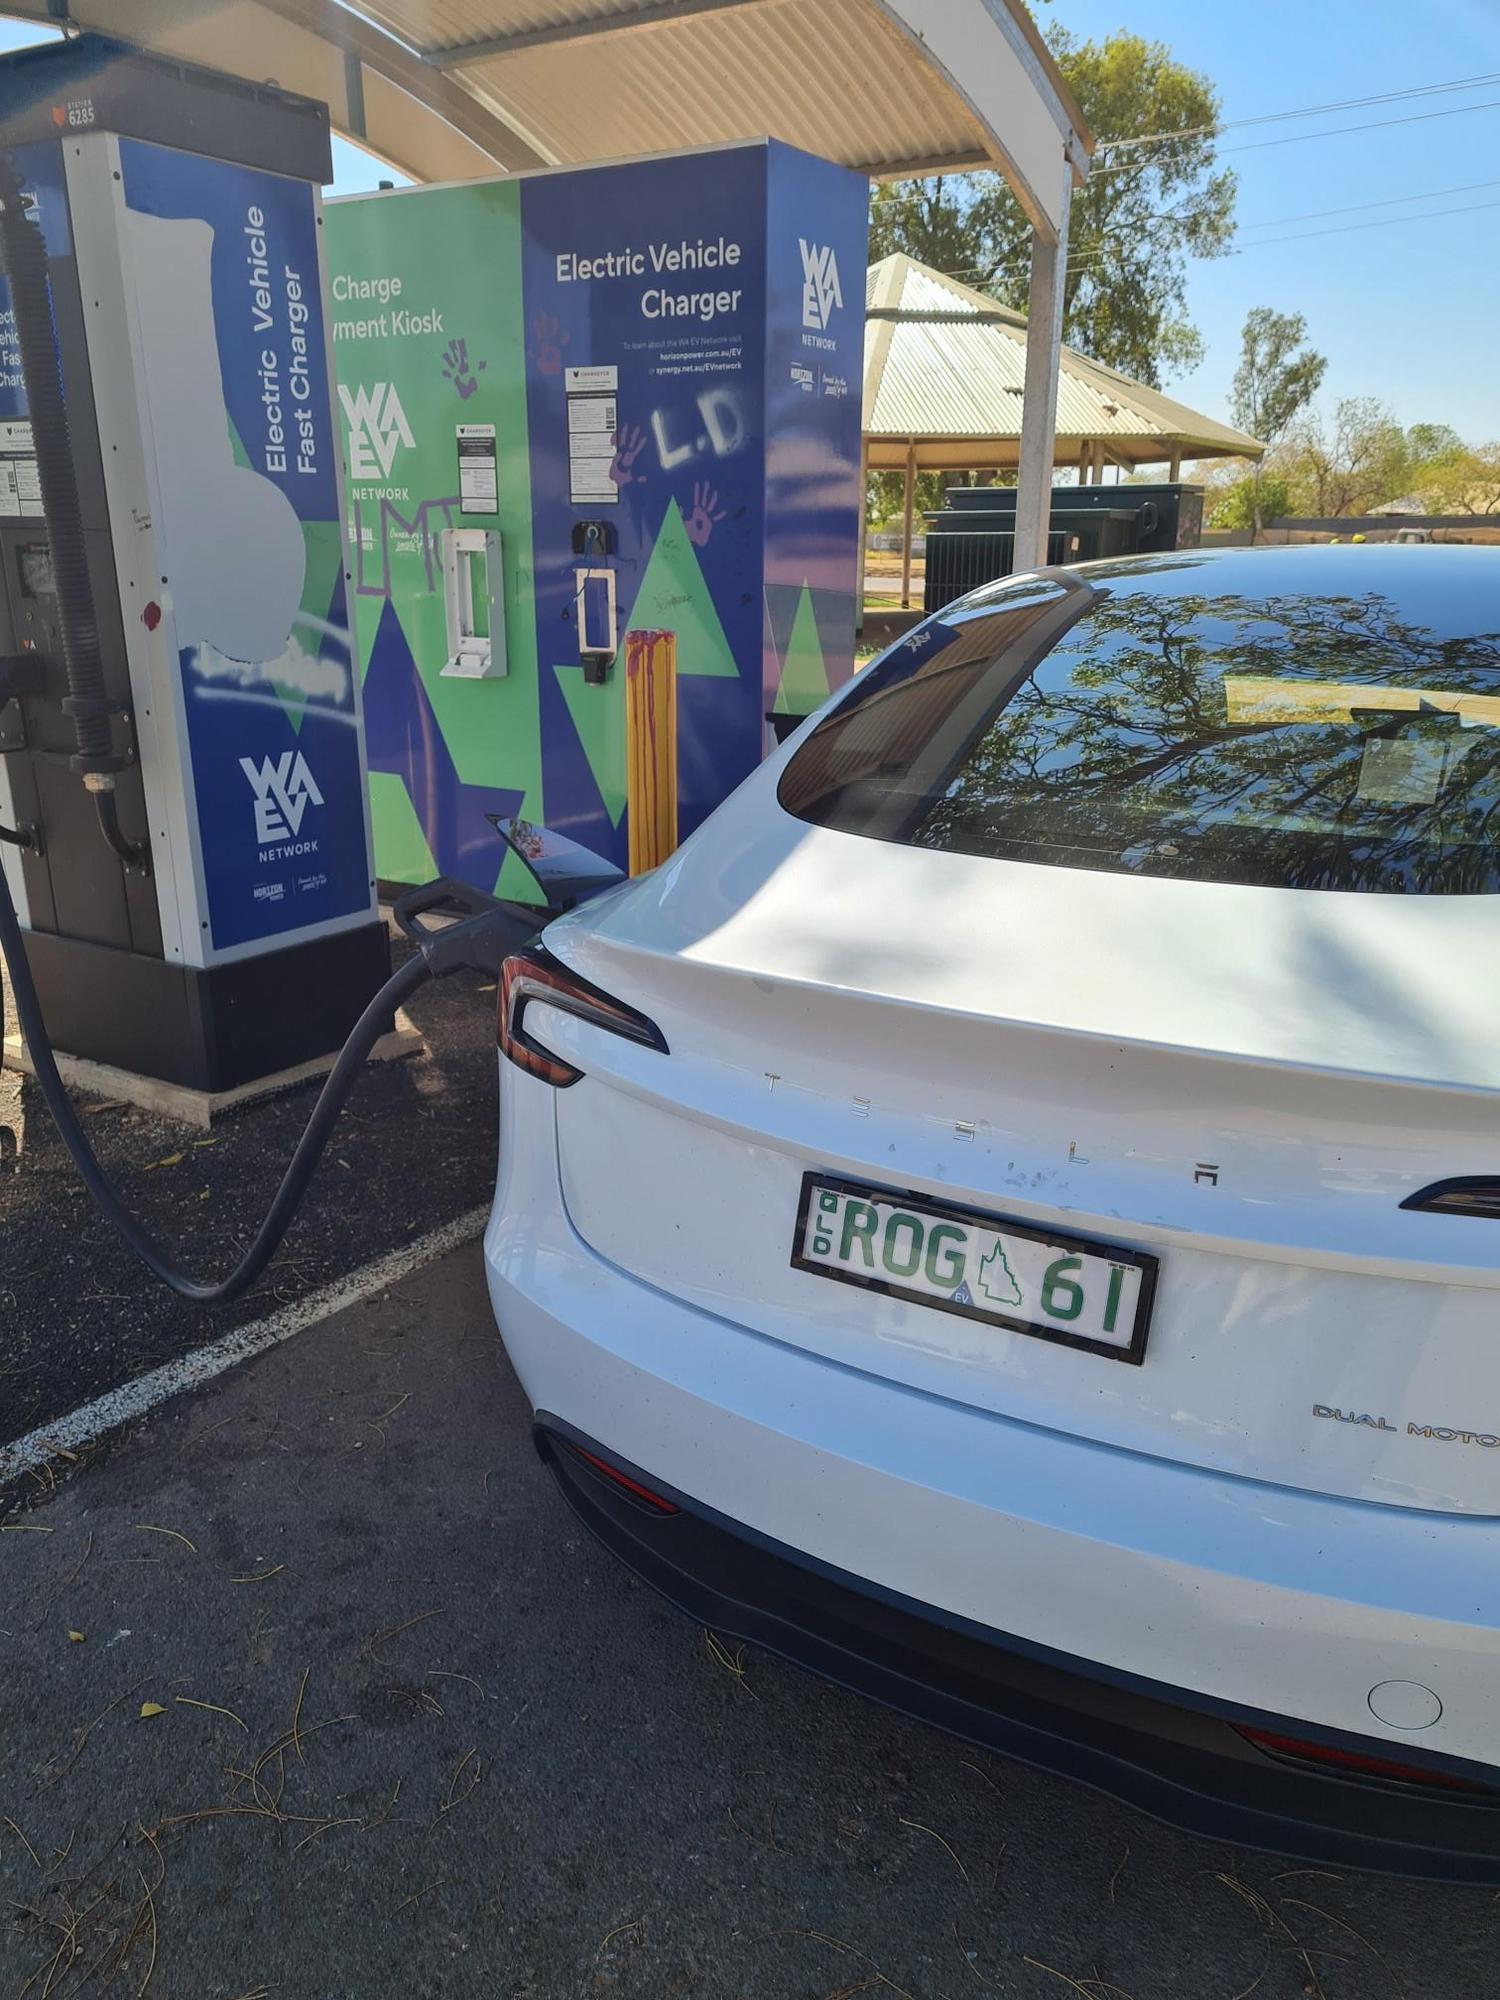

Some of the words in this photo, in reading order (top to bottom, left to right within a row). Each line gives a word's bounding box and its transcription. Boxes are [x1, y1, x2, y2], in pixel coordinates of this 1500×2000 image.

[68, 107, 95, 126] 6285
[244, 206, 273, 332] Vehicle
[556, 247, 645, 282] Electric
[648, 237, 742, 272] Vehicle
[332, 274, 402, 304] Charge
[641, 289, 742, 322] Charger
[285, 265, 311, 401] Charger
[391, 307, 444, 337] Kiosk
[802, 334, 837, 351] NETWORK
[258, 349, 287, 473] Electric
[294, 408, 317, 474] Fast
[352, 487, 410, 501] NETWORK
[259, 840, 318, 863] NETWORK
[838, 1199, 968, 1289] ROG
[1040, 1257, 1124, 1332] 61
[954, 1292, 969, 1305] EV
[1312, 1404, 1398, 1432] DUAL
